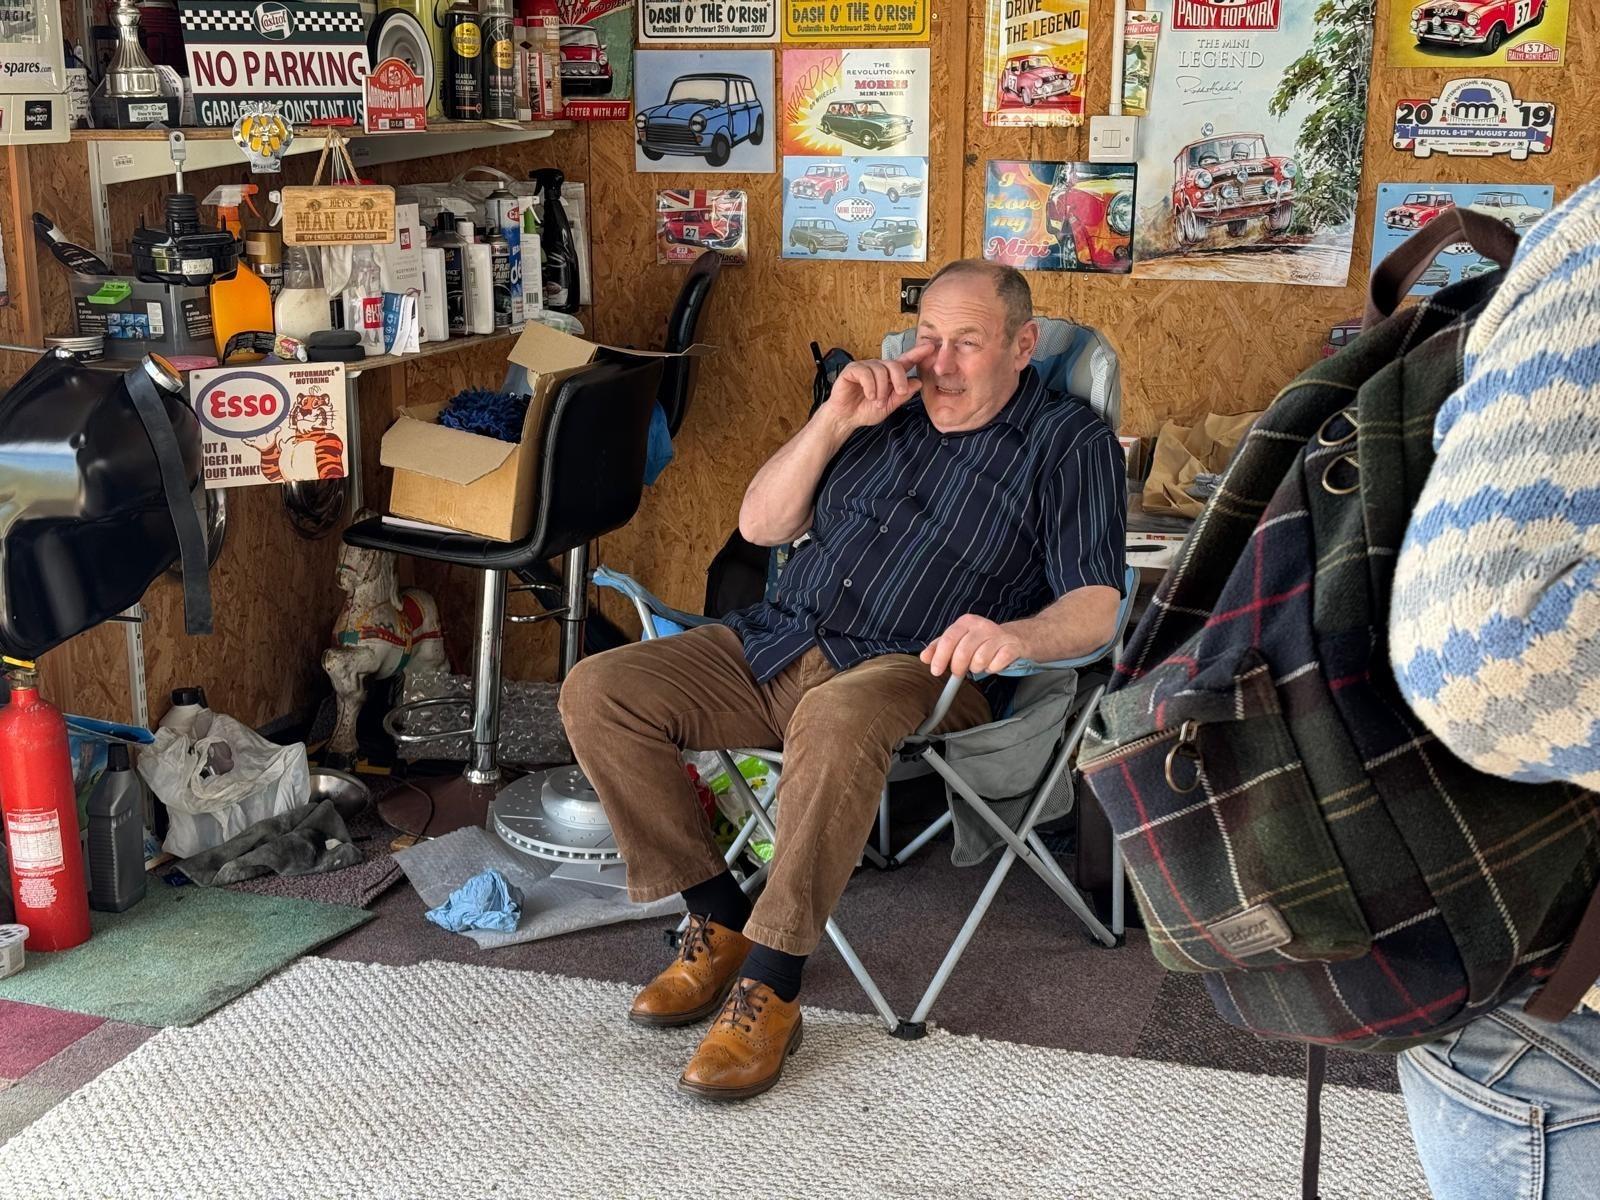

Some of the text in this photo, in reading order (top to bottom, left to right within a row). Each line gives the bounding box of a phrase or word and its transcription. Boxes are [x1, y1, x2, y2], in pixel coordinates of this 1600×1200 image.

[0, 10, 31, 22] AGIC
[648, 3, 768, 24] DASH O' THE O'RISH
[792, 3, 916, 23] DASH O' THE O'RISH
[1005, 0, 1043, 20] DRIVE
[1177, 0, 1275, 26] PADDY HOPKIRK
[1516, 2, 1530, 25] 37
[260, 10, 287, 32] Castrol
[877, 23, 897, 32] August
[1005, 9, 1081, 46] THE LEGEND
[679, 25, 684, 33] to
[731, 25, 750, 34] August
[1197, 39, 1250, 48] THE MINI
[1527, 44, 1541, 52] 37
[1178, 51, 1265, 69] LEGEND
[192, 50, 237, 87] NO
[243, 51, 366, 87] PARKING
[854, 80, 909, 89] MORRIS
[202, 100, 252, 126] GARA
[565, 106, 627, 117] BETTER WITH AGE
[1397, 104, 1434, 125] 20
[1519, 105, 1551, 128] 19
[1508, 130, 1527, 138] 2019
[295, 210, 388, 232] MAN CAVE
[685, 227, 697, 238] 27
[985, 235, 1051, 258] Mini
[365, 314, 382, 324] GLY
[289, 368, 336, 379] PERFORMANCE
[295, 377, 330, 385] MOTORING
[220, 442, 228, 453] A
[203, 454, 242, 467] IGER IN
[204, 465, 261, 479] OUR TANK!
